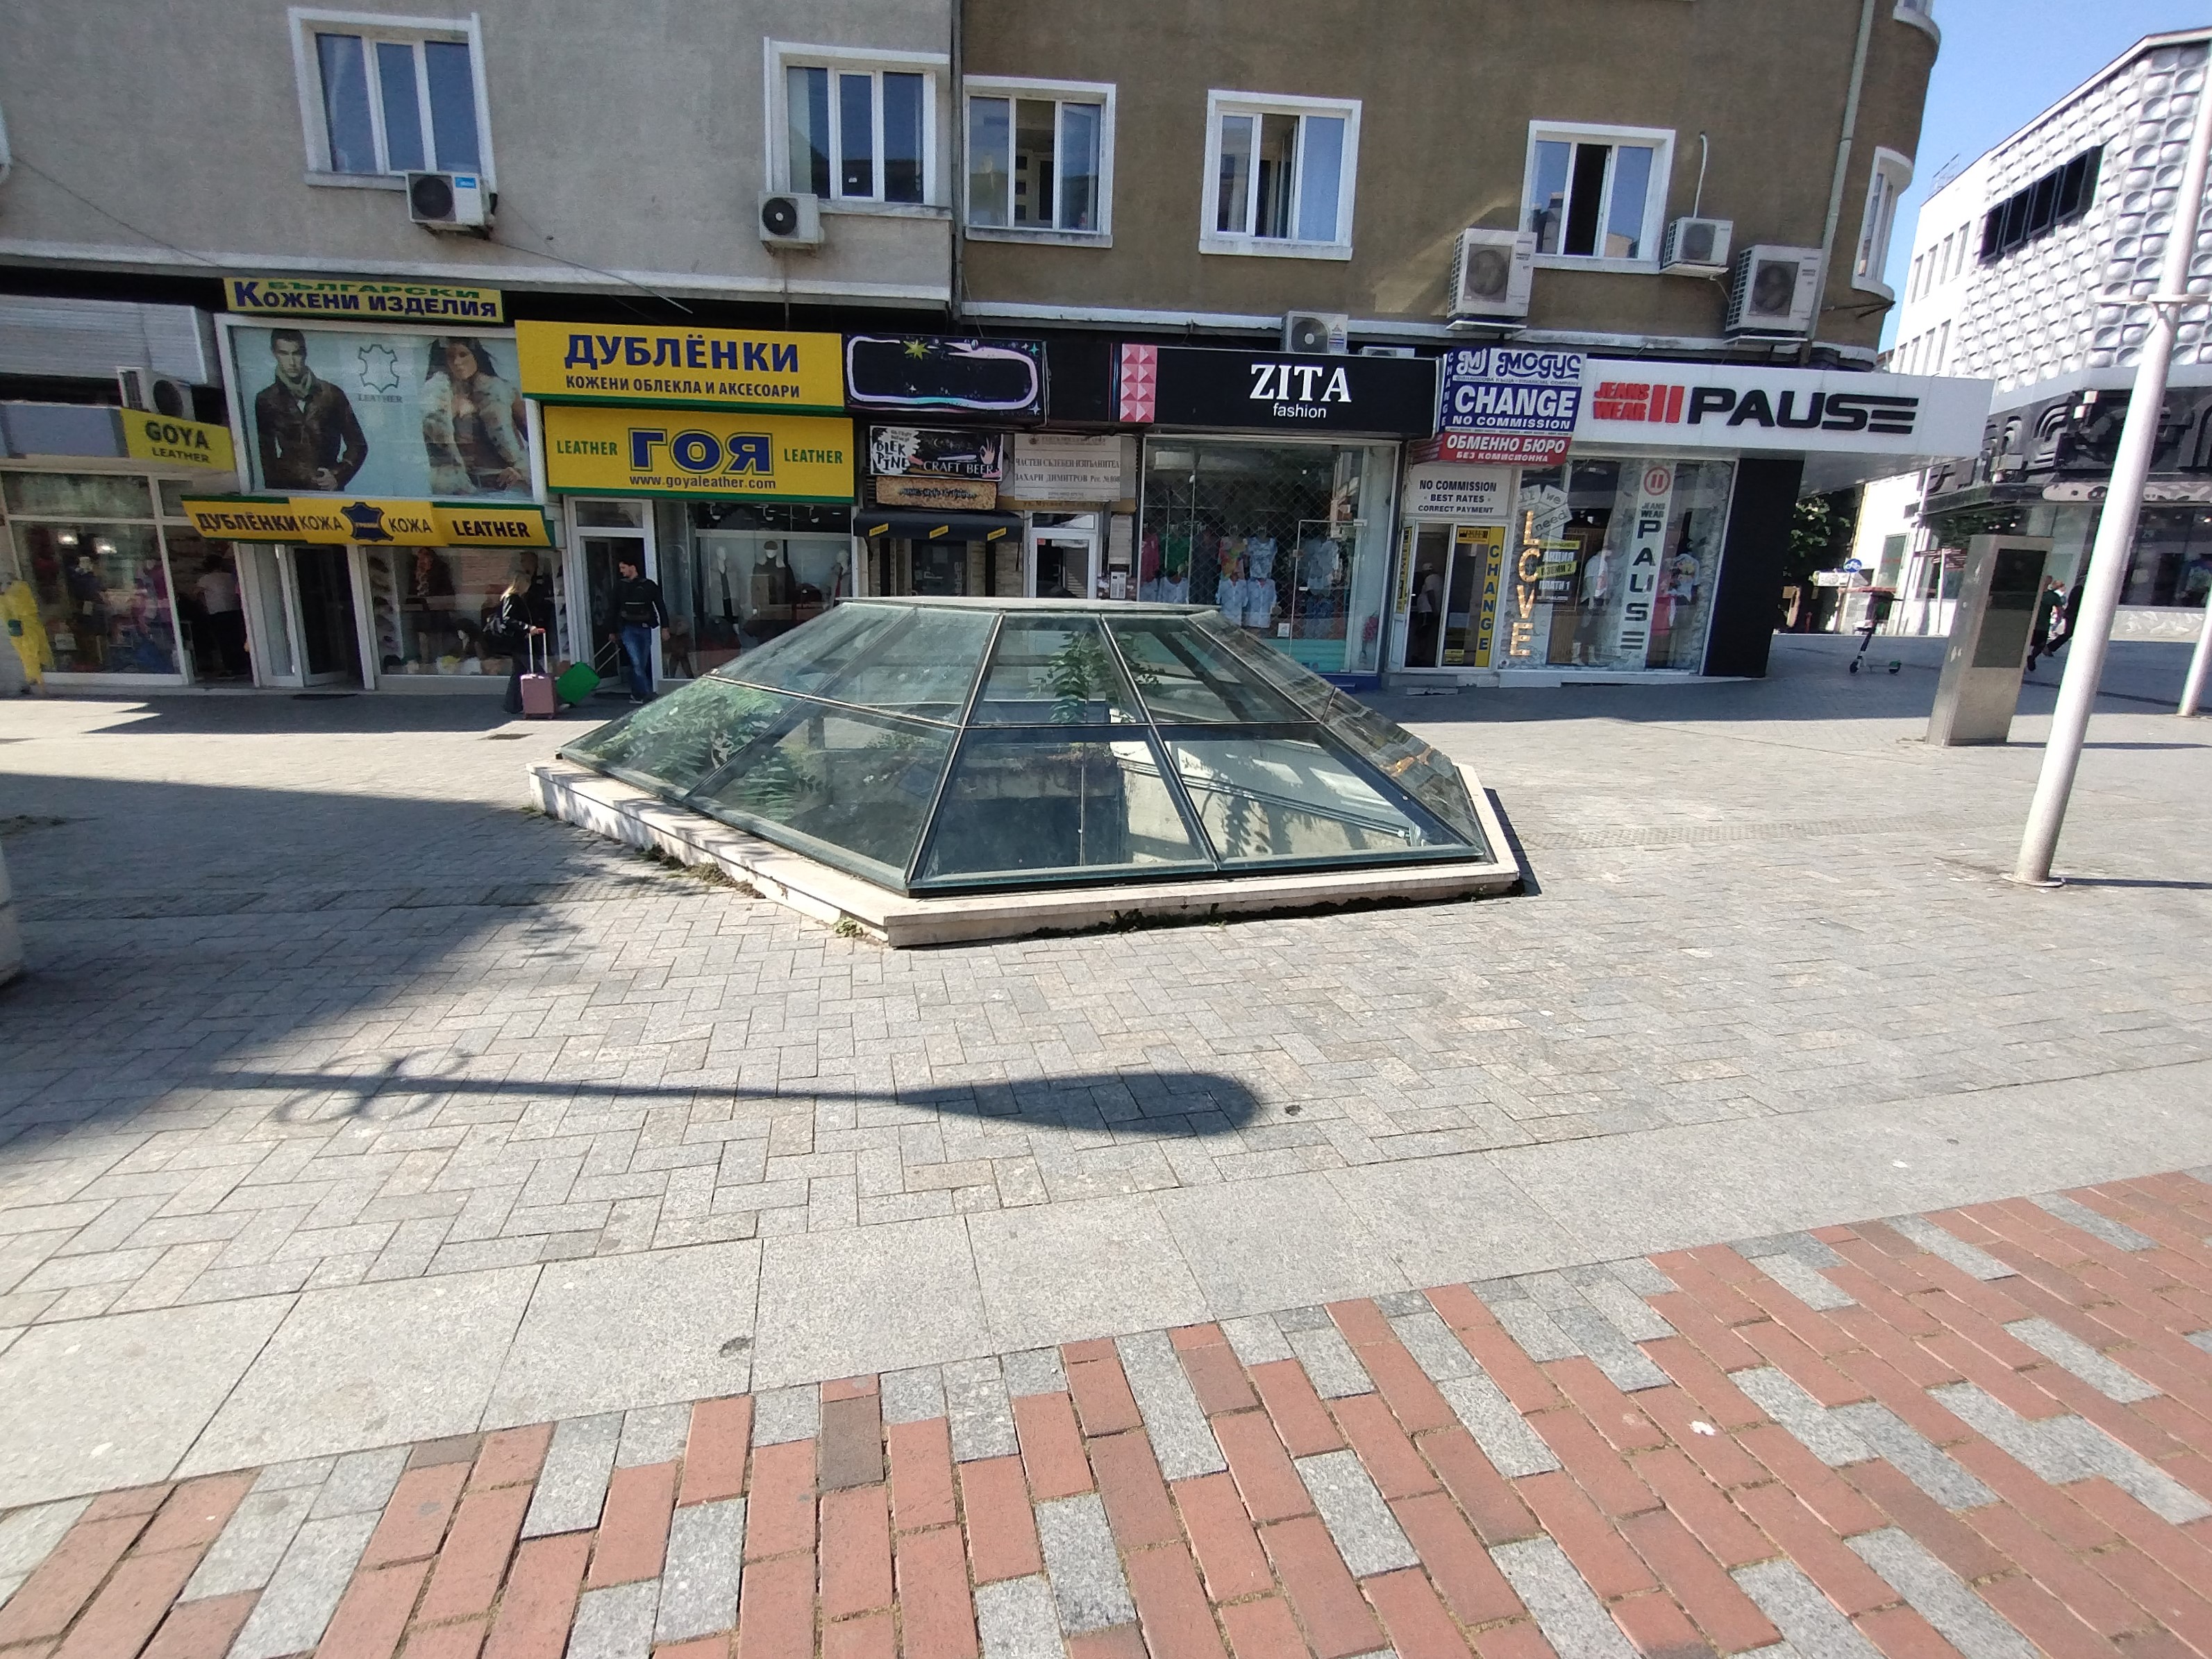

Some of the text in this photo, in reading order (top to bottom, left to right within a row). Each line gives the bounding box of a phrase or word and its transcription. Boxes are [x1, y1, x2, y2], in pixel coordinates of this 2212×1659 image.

[268, 281, 480, 299] БЪЛГАРСКИ
[369, 295, 497, 317] ИЗДЕЛИЯ
[564, 334, 798, 373] ДУБЛЁНКИ
[566, 375, 800, 398] КОЖЕНИ ОБЛЕКЛА И АКСЕСОАРИ
[1249, 364, 1352, 403] ZITA
[1441, 352, 1454, 427] CHANGE
[1593, 382, 1650, 401] JEANS
[358, 394, 403, 404] LEATHER
[1454, 385, 1577, 418] CHANGE
[1273, 402, 1327, 419] fashion
[1593, 401, 1648, 421] WEAR
[1686, 387, 1920, 435] PAUSE
[1452, 415, 1571, 430] NO COMMISSION
[145, 419, 211, 450] GOYA
[556, 439, 619, 456] LEATHER
[628, 427, 774, 476] ГОЯ
[876, 439, 906, 456] BLEK
[1446, 435, 1520, 453] ОБМЕННО
[1522, 438, 1566, 454] БЮРО
[151, 446, 211, 464] LEATHER
[783, 448, 844, 464] LEATHER
[1456, 451, 1475, 460] БЕЗ
[923, 460, 994, 475] CRAFT BEER
[629, 475, 776, 490] www.goyaleather.com
[1419, 480, 1497, 492] NO COMMISSION
[1430, 494, 1484, 503] BEST RATES
[1546, 493, 1561, 505] we
[1641, 502, 1666, 510] JEANS
[1418, 505, 1455, 513] CORRECT
[1641, 510, 1664, 518] WEAR
[194, 511, 301, 532] ДУБЛЁНКИ
[297, 516, 345, 531] КОЖА
[388, 518, 433, 534] КОЖА
[451, 520, 531, 538] LEATHER
[1534, 509, 1568, 532] need
[1567, 564, 1572, 572] 2
[1620, 519, 1661, 650] PAUSE
[1478, 544, 1500, 650] CHANGE
